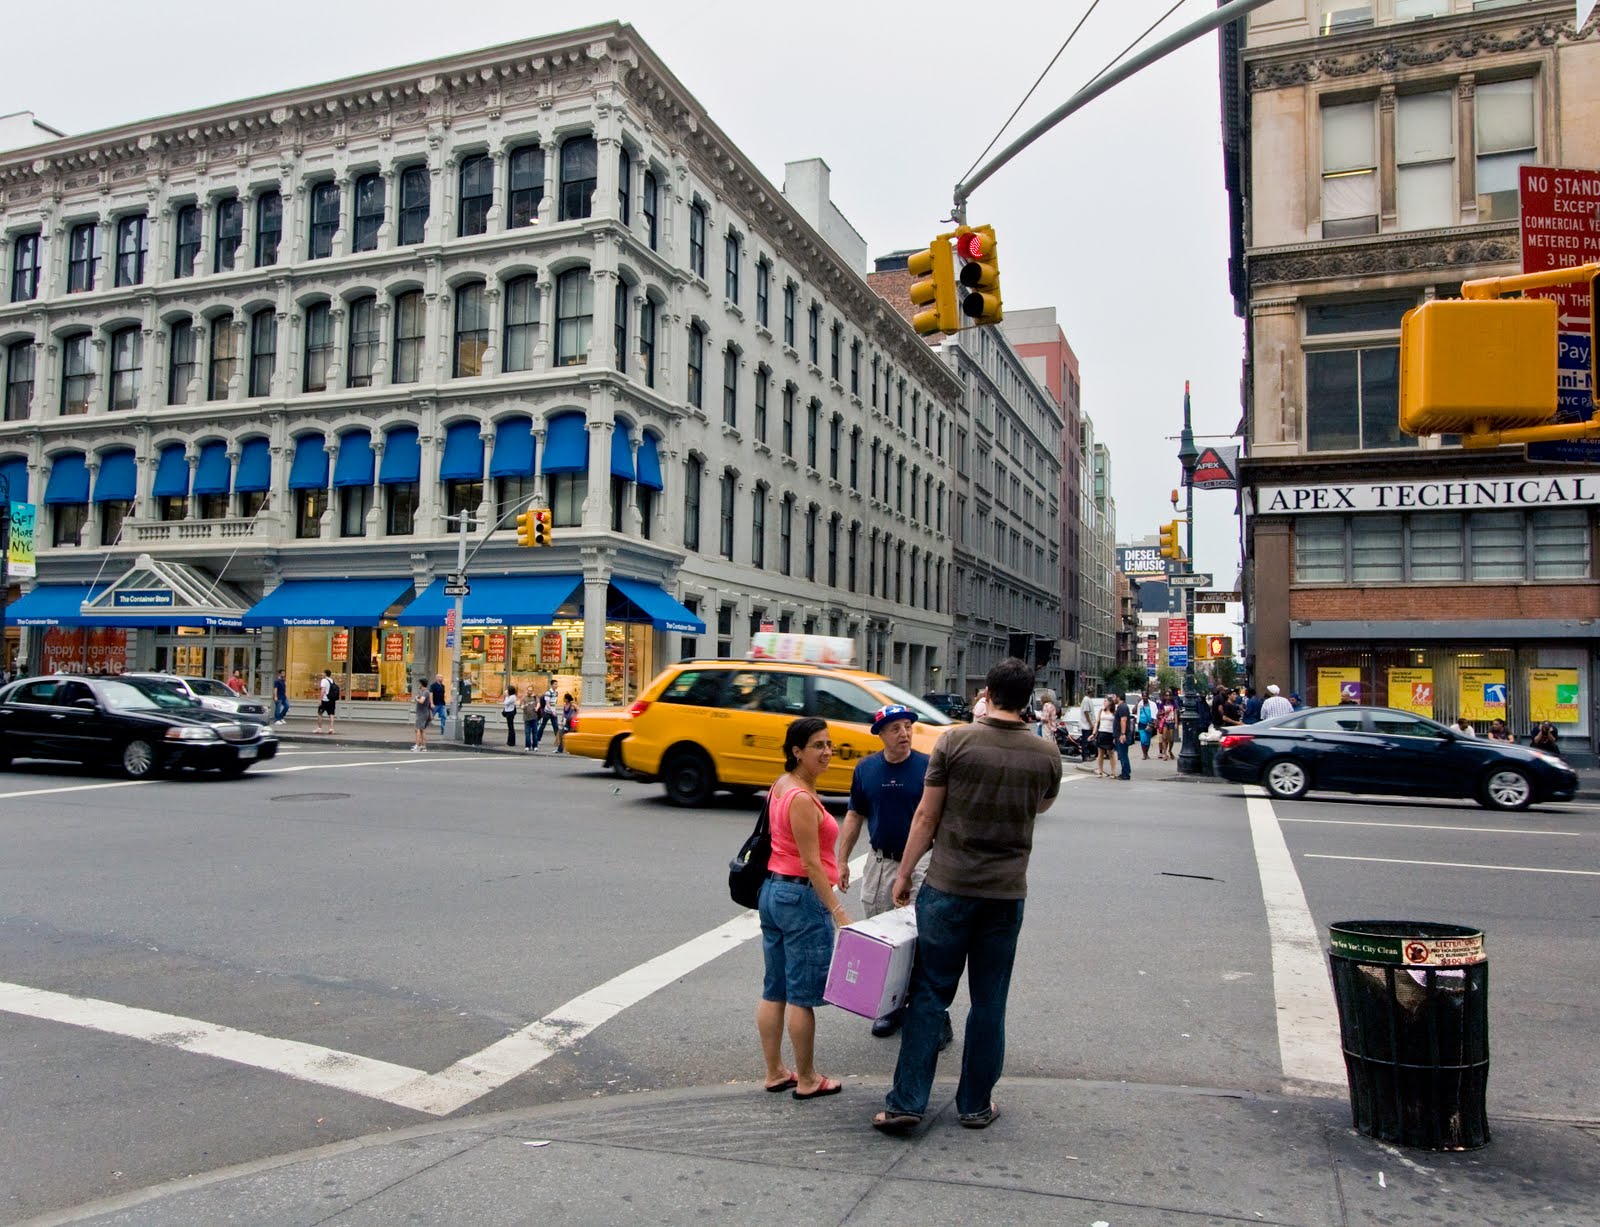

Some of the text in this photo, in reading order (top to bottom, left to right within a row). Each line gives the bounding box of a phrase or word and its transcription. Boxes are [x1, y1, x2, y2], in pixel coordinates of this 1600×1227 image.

[1528, 176, 1548, 193] NO
[1525, 216, 1585, 231] COMMERCIAL
[1528, 234, 1580, 249] METERED
[1547, 253, 1555, 266] 3
[1559, 254, 1577, 266] HR
[1559, 341, 1589, 363] Pay
[1196, 462, 1219, 470] APEX
[1268, 478, 1596, 511] APEX TECHNICAL
[11, 511, 34, 526] GET
[11, 539, 34, 554] NYC
[1125, 550, 1161, 560] DIESEL:
[1125, 560, 1165, 571] U:MUSIC
[155, 595, 170, 603] Store
[1201, 604, 1220, 613] 6 AV
[206, 617, 217, 625] The
[489, 637, 504, 645] appy
[44, 641, 126, 658] happy organize
[487, 654, 504, 662] sale
[542, 654, 560, 663] sale
[94, 658, 123, 674] sale
[1362, 944, 1376, 954] City
[1377, 946, 1398, 955] Clean
